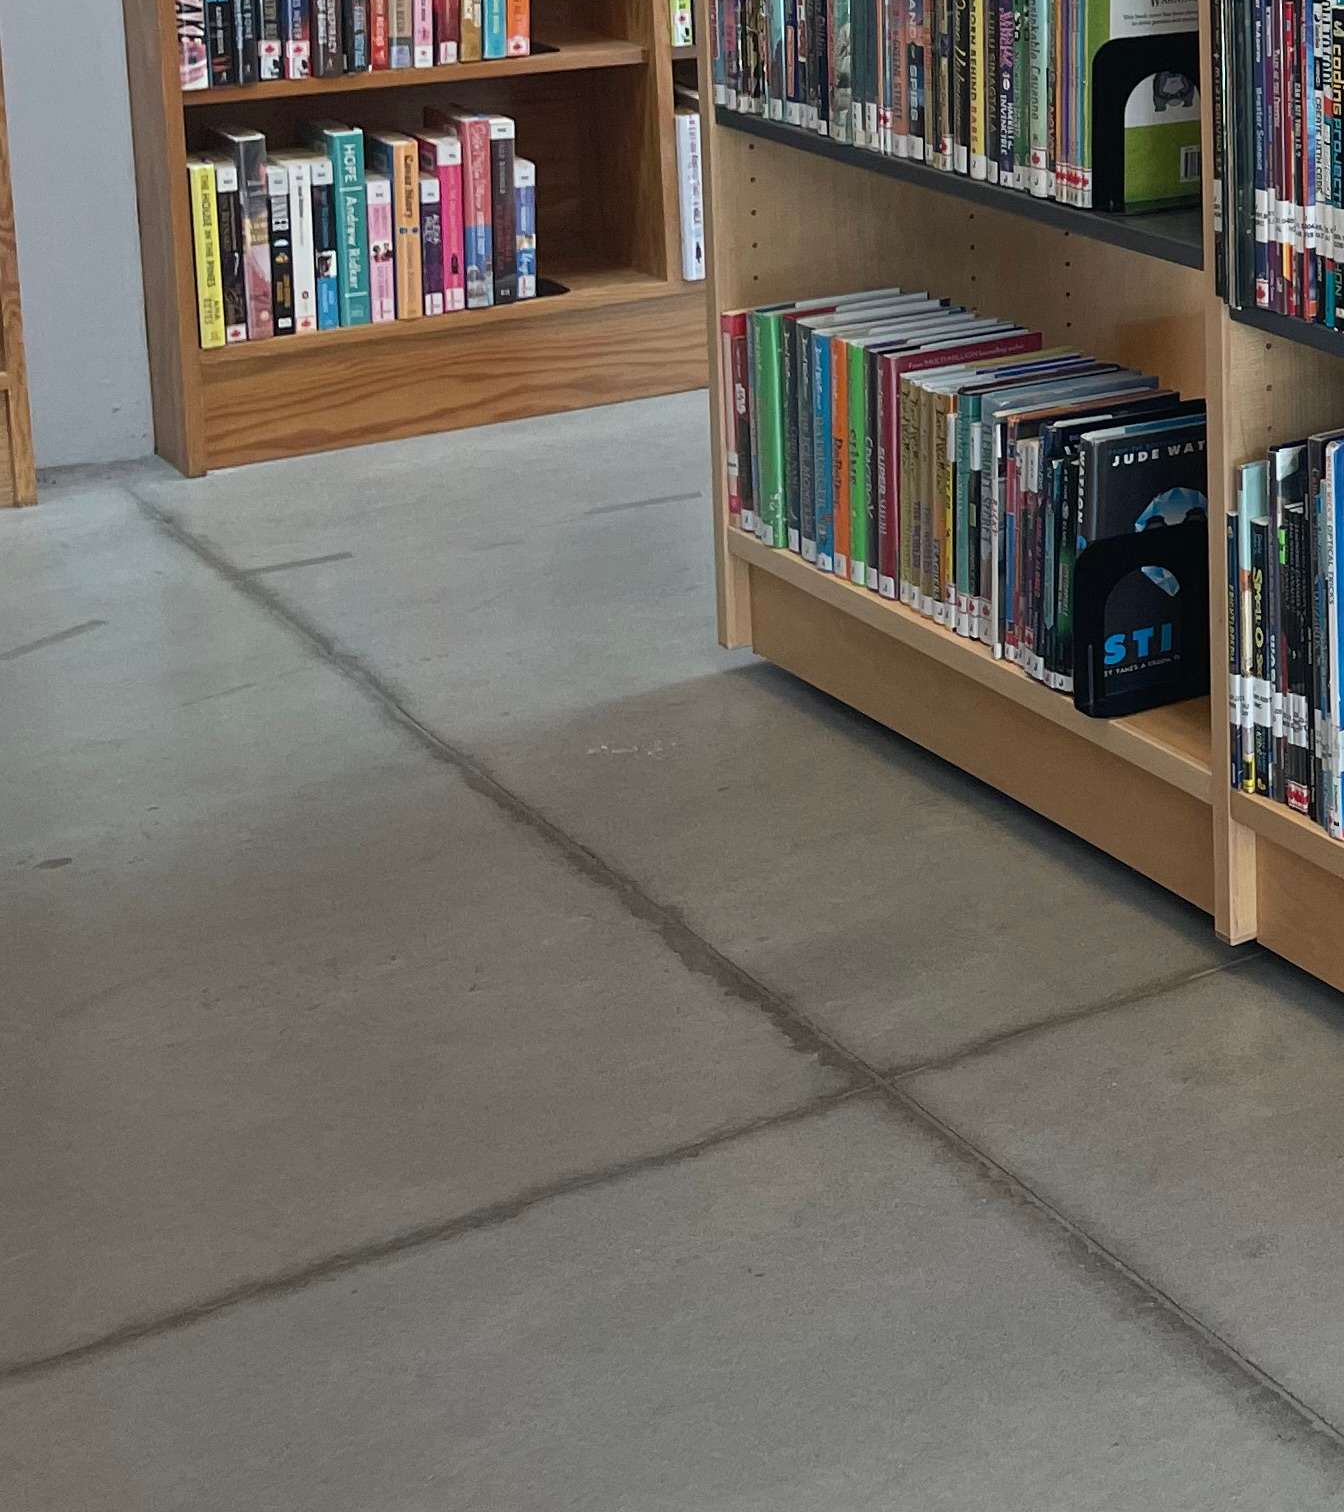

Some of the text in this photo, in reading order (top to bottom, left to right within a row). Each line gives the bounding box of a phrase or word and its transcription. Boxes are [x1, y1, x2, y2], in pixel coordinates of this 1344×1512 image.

[341, 143, 358, 185] HOPE
[1112, 440, 1206, 468] JUDE WAT
[1078, 450, 1086, 524] WATSON
[1103, 623, 1173, 666] STI
